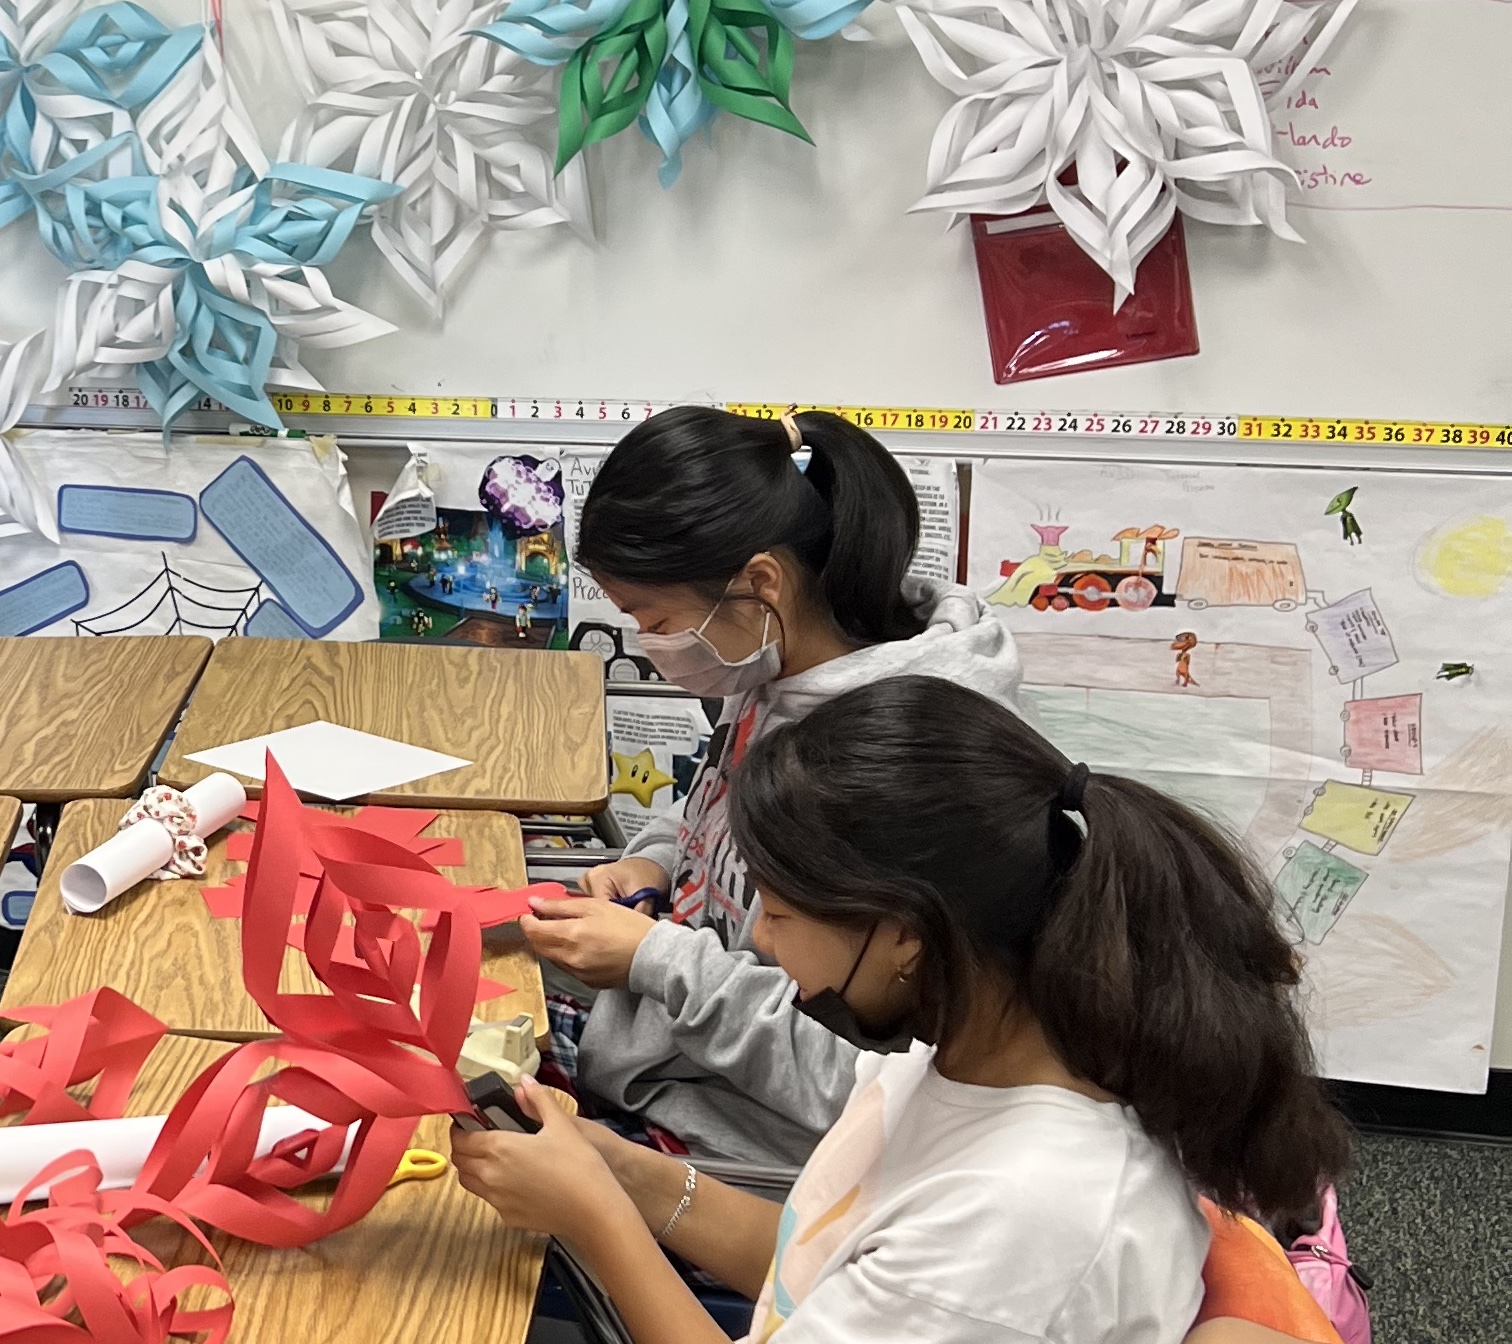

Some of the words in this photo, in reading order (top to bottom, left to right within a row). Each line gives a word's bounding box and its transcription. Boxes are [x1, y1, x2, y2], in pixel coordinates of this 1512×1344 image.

[73, 394, 88, 406] 20
[93, 394, 109, 406] 19
[114, 395, 130, 408] 18
[530, 405, 539, 418] 2
[553, 405, 562, 419] 3
[576, 405, 585, 419] 4
[598, 406, 607, 420] 5
[621, 407, 630, 420] 6
[855, 412, 873, 426] 16
[881, 413, 899, 426] 17
[906, 414, 924, 428] 18
[930, 414, 948, 428] 19
[953, 415, 972, 429] 20
[980, 415, 998, 430] 21
[1006, 416, 1026, 430] 22
[1032, 417, 1052, 431] 23
[1058, 417, 1078, 432] 24
[1085, 418, 1105, 432] 25
[1111, 419, 1132, 433] 26
[1138, 419, 1159, 434] 27
[1165, 420, 1186, 435] 28
[1191, 421, 1212, 435] 29
[1217, 421, 1237, 436] 30
[1243, 422, 1263, 437] 31
[1271, 423, 1292, 438] 32
[1299, 424, 1320, 439] 33
[1326, 425, 1348, 440] 34
[1354, 425, 1376, 441] 35
[1383, 427, 1405, 442] 36
[1412, 427, 1434, 443] 37
[1440, 428, 1462, 444] 38
[1467, 429, 1490, 444] 39
